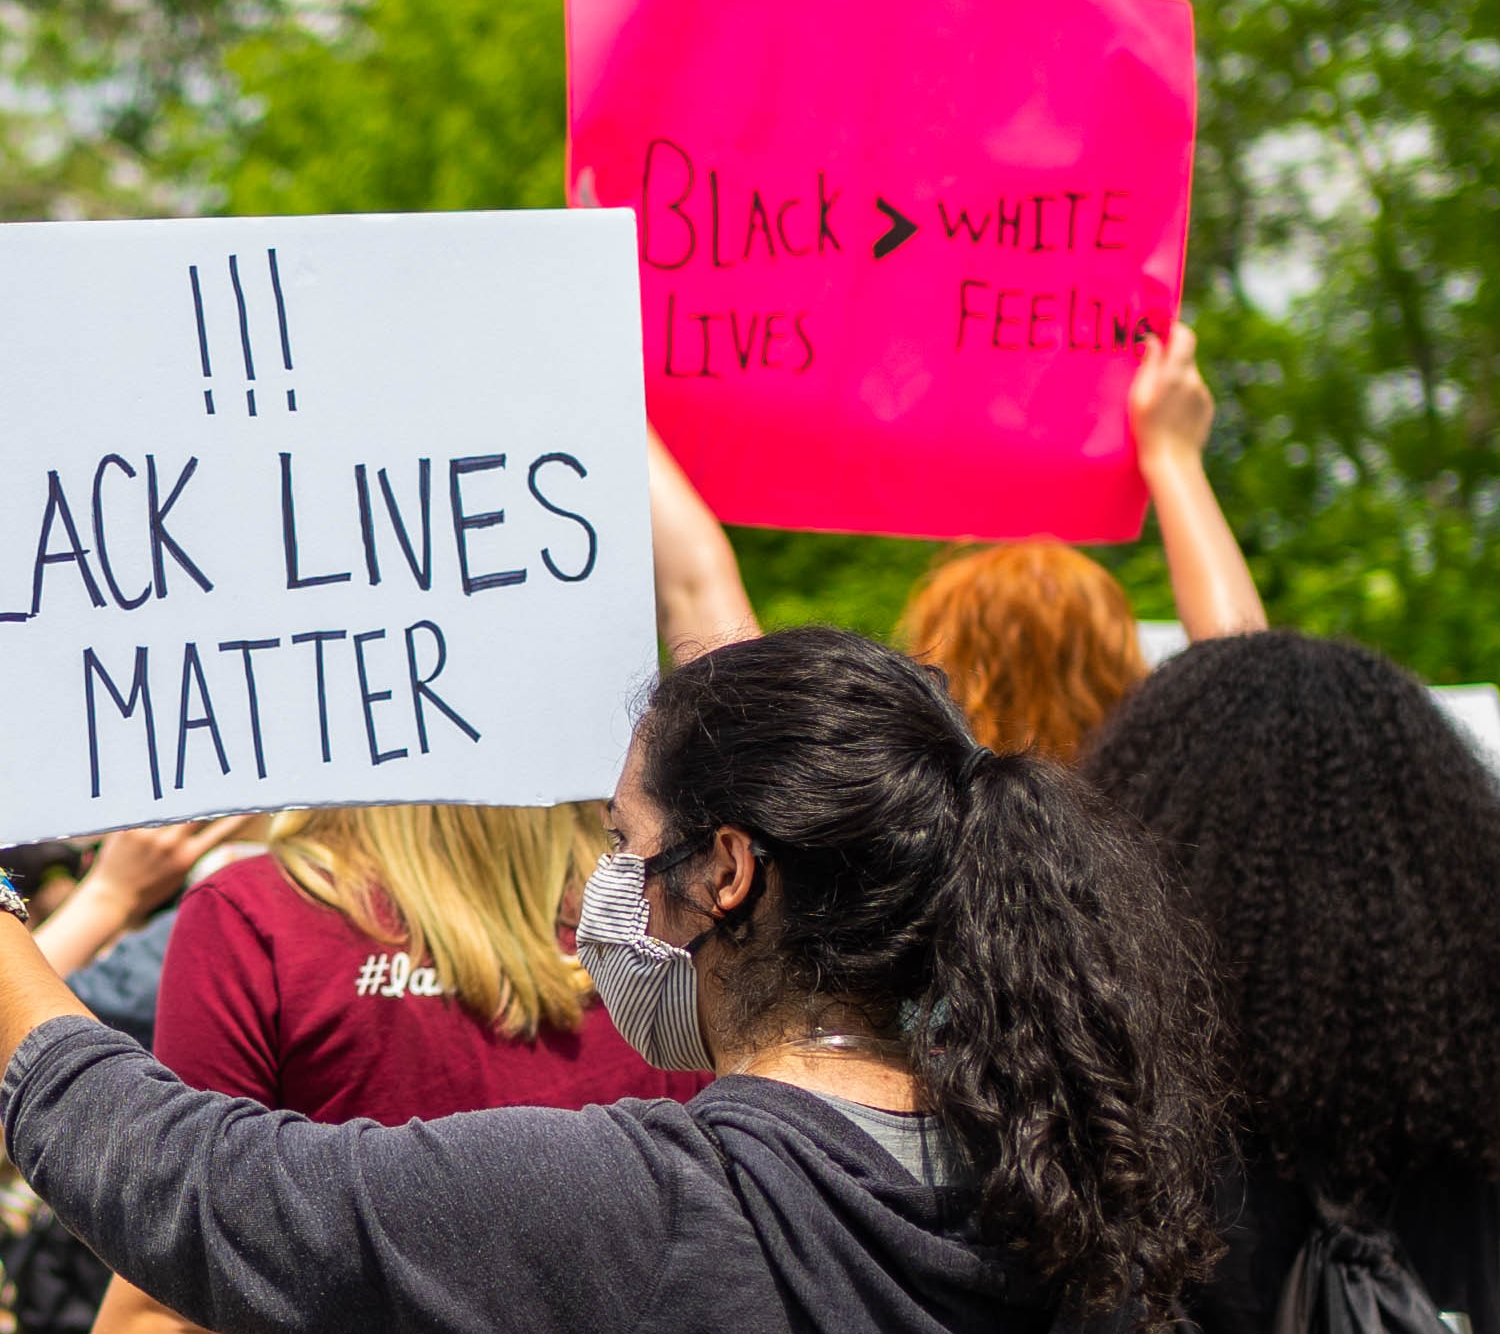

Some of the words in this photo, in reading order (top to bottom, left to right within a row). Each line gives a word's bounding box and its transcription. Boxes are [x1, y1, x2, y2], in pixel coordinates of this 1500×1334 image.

[937, 190, 1130, 252] WHITE
[189, 248, 298, 417] !!!
[664, 293, 814, 378] LIVES
[279, 451, 599, 596] LIVES
[82, 619, 482, 801] MATTER
